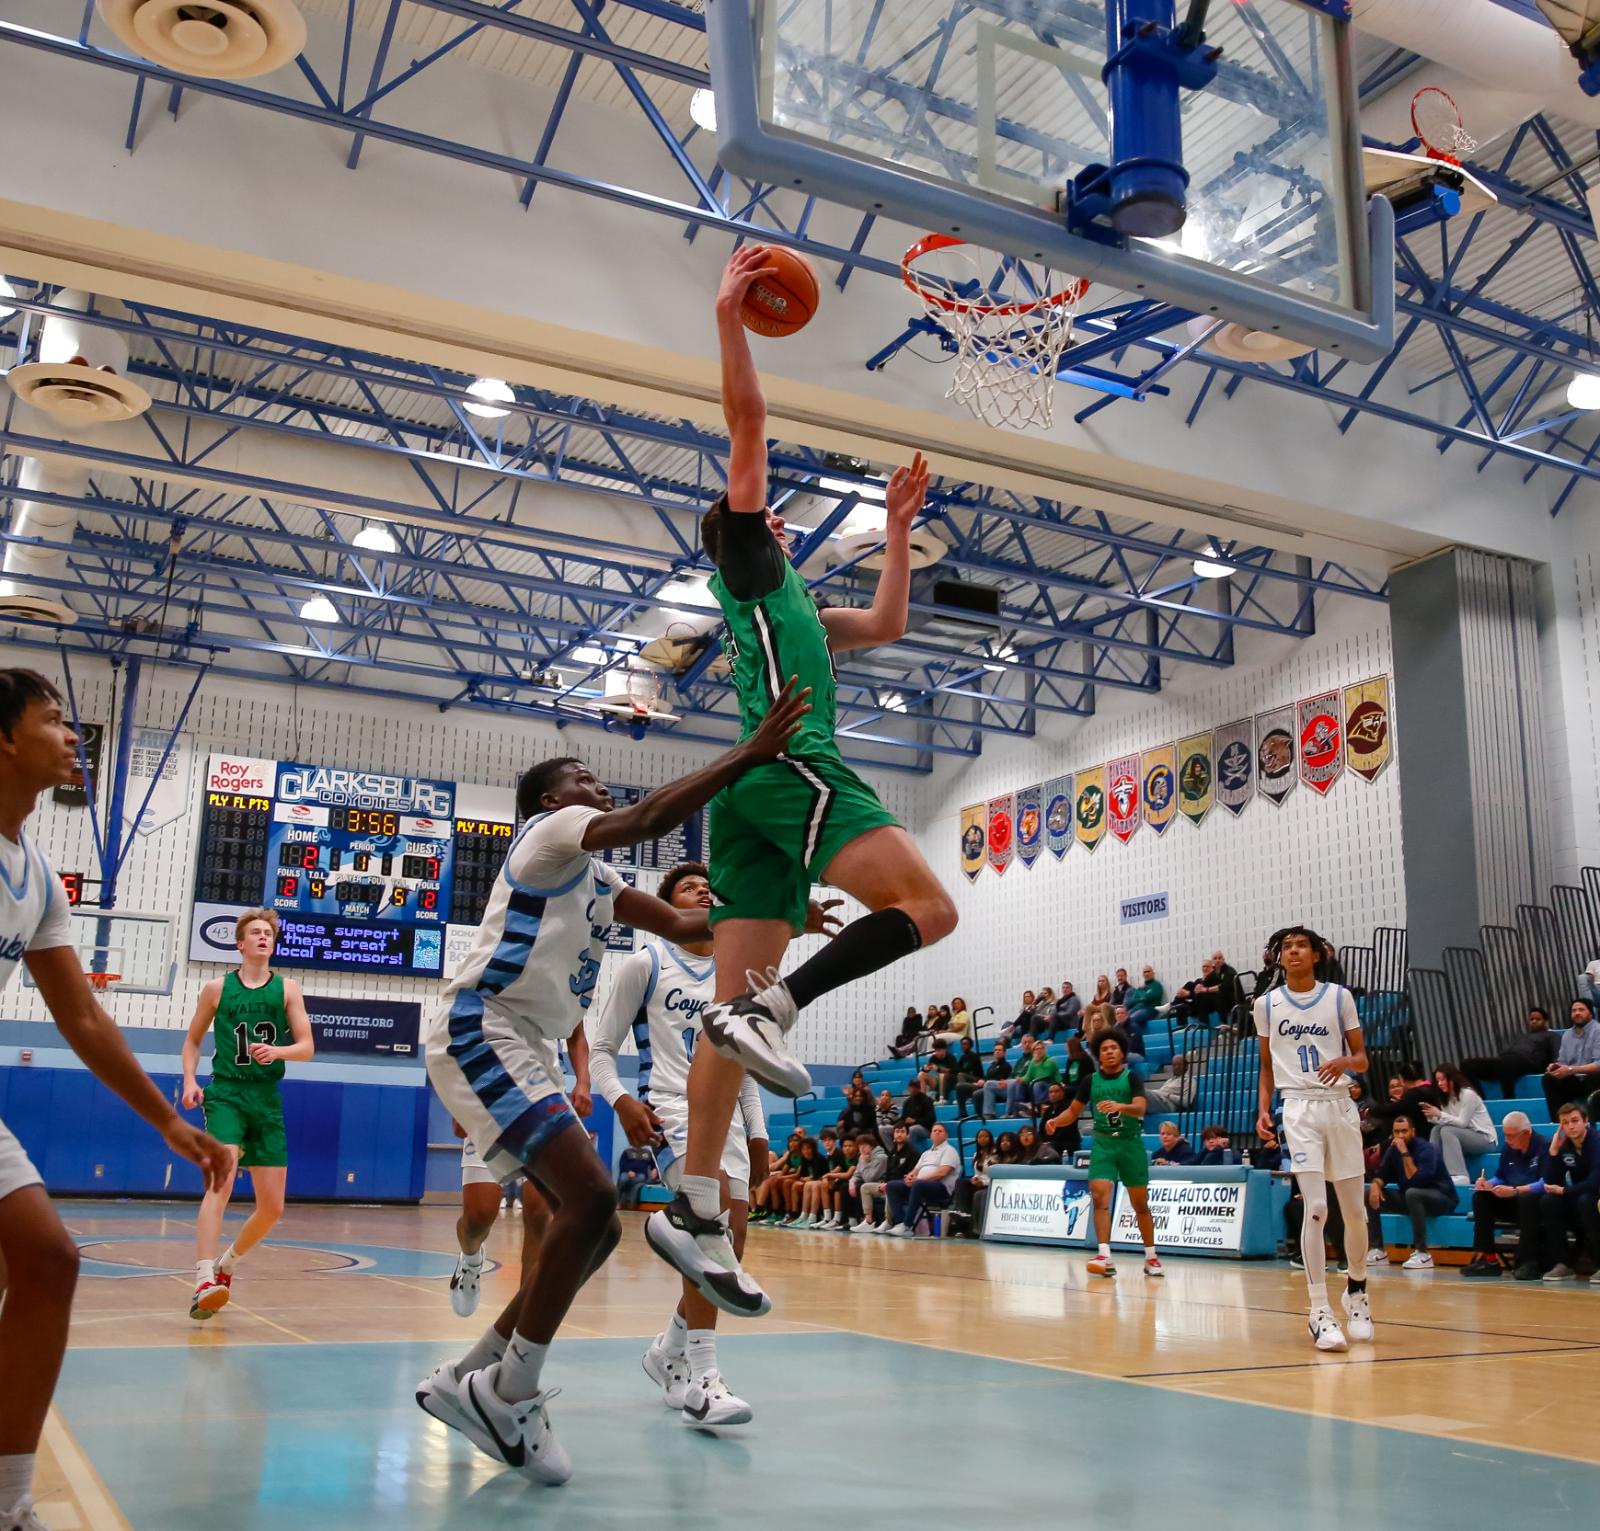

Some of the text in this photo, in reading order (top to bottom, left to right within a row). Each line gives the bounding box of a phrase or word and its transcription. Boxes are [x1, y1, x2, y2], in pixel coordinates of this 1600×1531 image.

[221, 762, 249, 778] Roy
[211, 775, 263, 791] Rogers
[280, 768, 450, 817] CLARKSBURG
[319, 789, 411, 812] COYOTES
[209, 794, 269, 811] PLY FL PTS
[348, 810, 395, 836] 3:56
[457, 821, 511, 837] PLY FL PTS
[287, 829, 318, 842] HOME
[349, 842, 376, 851] PERIOD
[405, 842, 439, 854] GUEST
[303, 846, 318, 869] 2
[361, 855, 366, 870] 1
[277, 868, 300, 877] FOULS
[427, 858, 438, 879] 7
[283, 878, 296, 897] 2
[335, 874, 386, 885] PLAYER FOUL
[418, 881, 440, 890] FOULS
[311, 882, 322, 897] 4
[394, 888, 404, 906] 5
[274, 898, 298, 908] SCORE
[424, 891, 436, 909] 2
[1122, 898, 1166, 918] VISITORS
[345, 904, 370, 914] MATCH
[415, 910, 438, 920] SCORE
[278, 918, 399, 940] Please support
[284, 932, 387, 952] these great
[276, 943, 403, 965] local sponsors!
[228, 1002, 277, 1019] WALTER
[307, 1013, 394, 1028] HSCOYOTES.ORG
[323, 1028, 369, 1039] GO COYOTES!
[1279, 1019, 1329, 1040] Coyotes
[234, 1021, 276, 1066] 13
[1297, 1045, 1320, 1072] 11
[994, 1186, 1061, 1211] CLARKSBURG
[1147, 1187, 1239, 1203] SWELLAUTO.COM
[1148, 1205, 1171, 1214] MERICAN
[1178, 1206, 1236, 1217] HUMMER
[1001, 1212, 1050, 1224] HIGH SCHOOL
[1157, 1235, 1179, 1243] USED
[1183, 1236, 1223, 1246] VEHICLES
